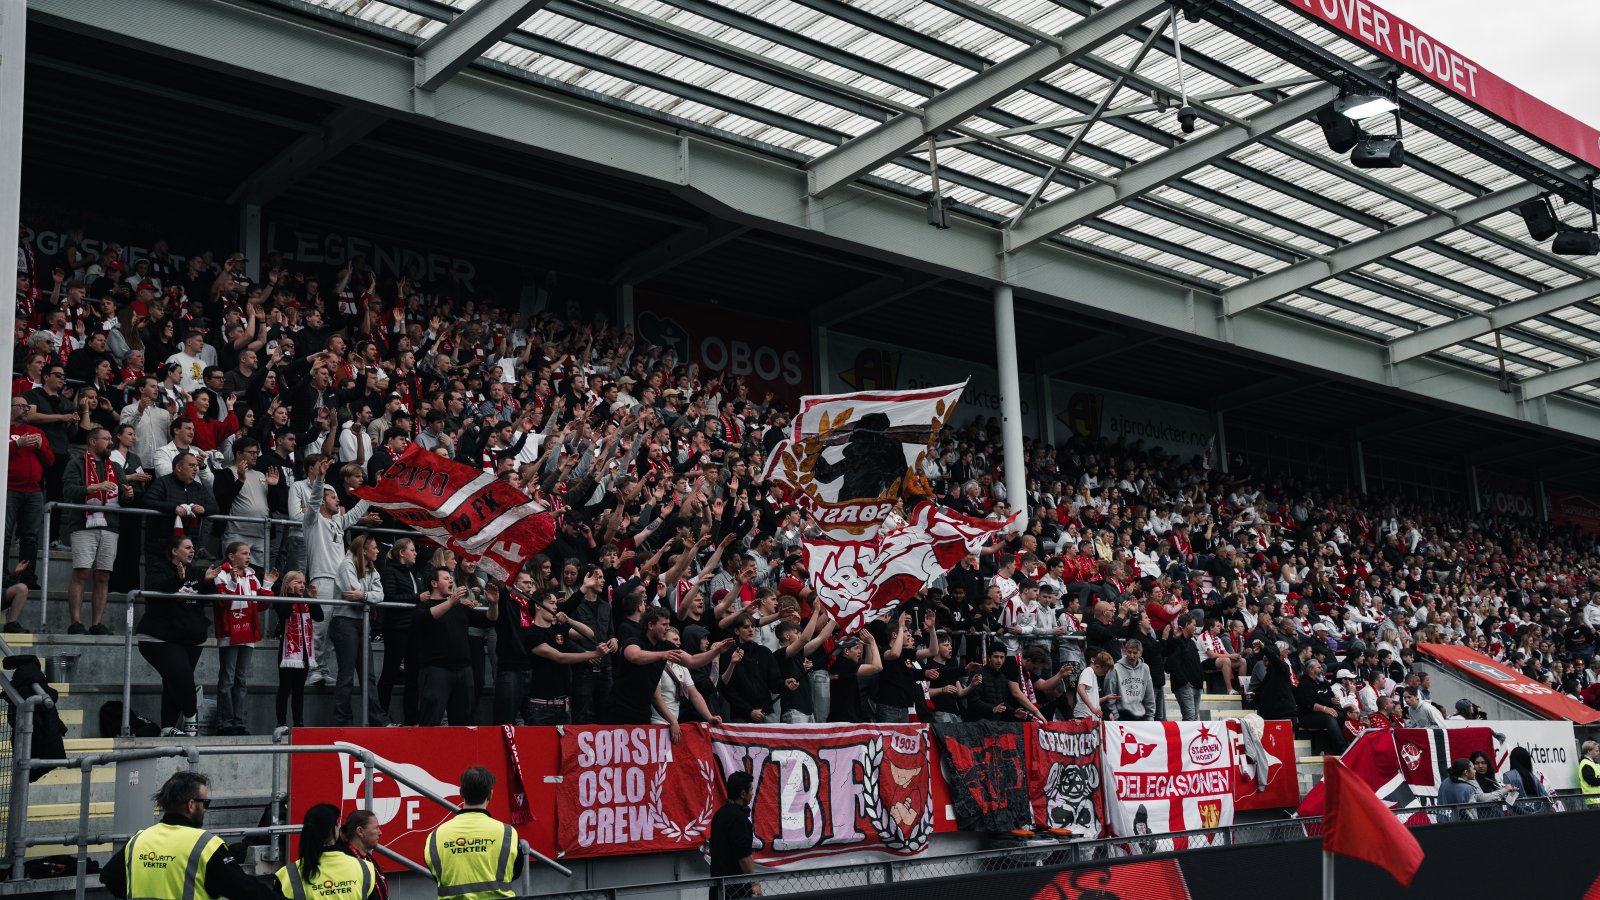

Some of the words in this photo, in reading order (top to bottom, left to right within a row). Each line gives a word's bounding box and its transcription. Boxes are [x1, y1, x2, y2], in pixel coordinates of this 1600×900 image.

[1320, 0, 1393, 53] OVER
[1398, 23, 1478, 98] HODET
[267, 222, 478, 293] LEGENDER
[701, 336, 802, 385] OBOS
[1110, 414, 1208, 447] ajprodukter.no
[1496, 491, 1535, 518] OBOS
[577, 727, 673, 768] SØRSIA
[893, 737, 917, 752] 1903
[578, 766, 646, 808] OSLO
[1117, 770, 1230, 799] DELEGASJONEN
[577, 804, 655, 848] CREW
[443, 837, 497, 849] SEQURITY
[451, 846, 487, 854] VEKTER
[143, 861, 167, 869] VEKTER
[311, 880, 358, 891] SEQURITY
[320, 887, 352, 897] VEKTER
